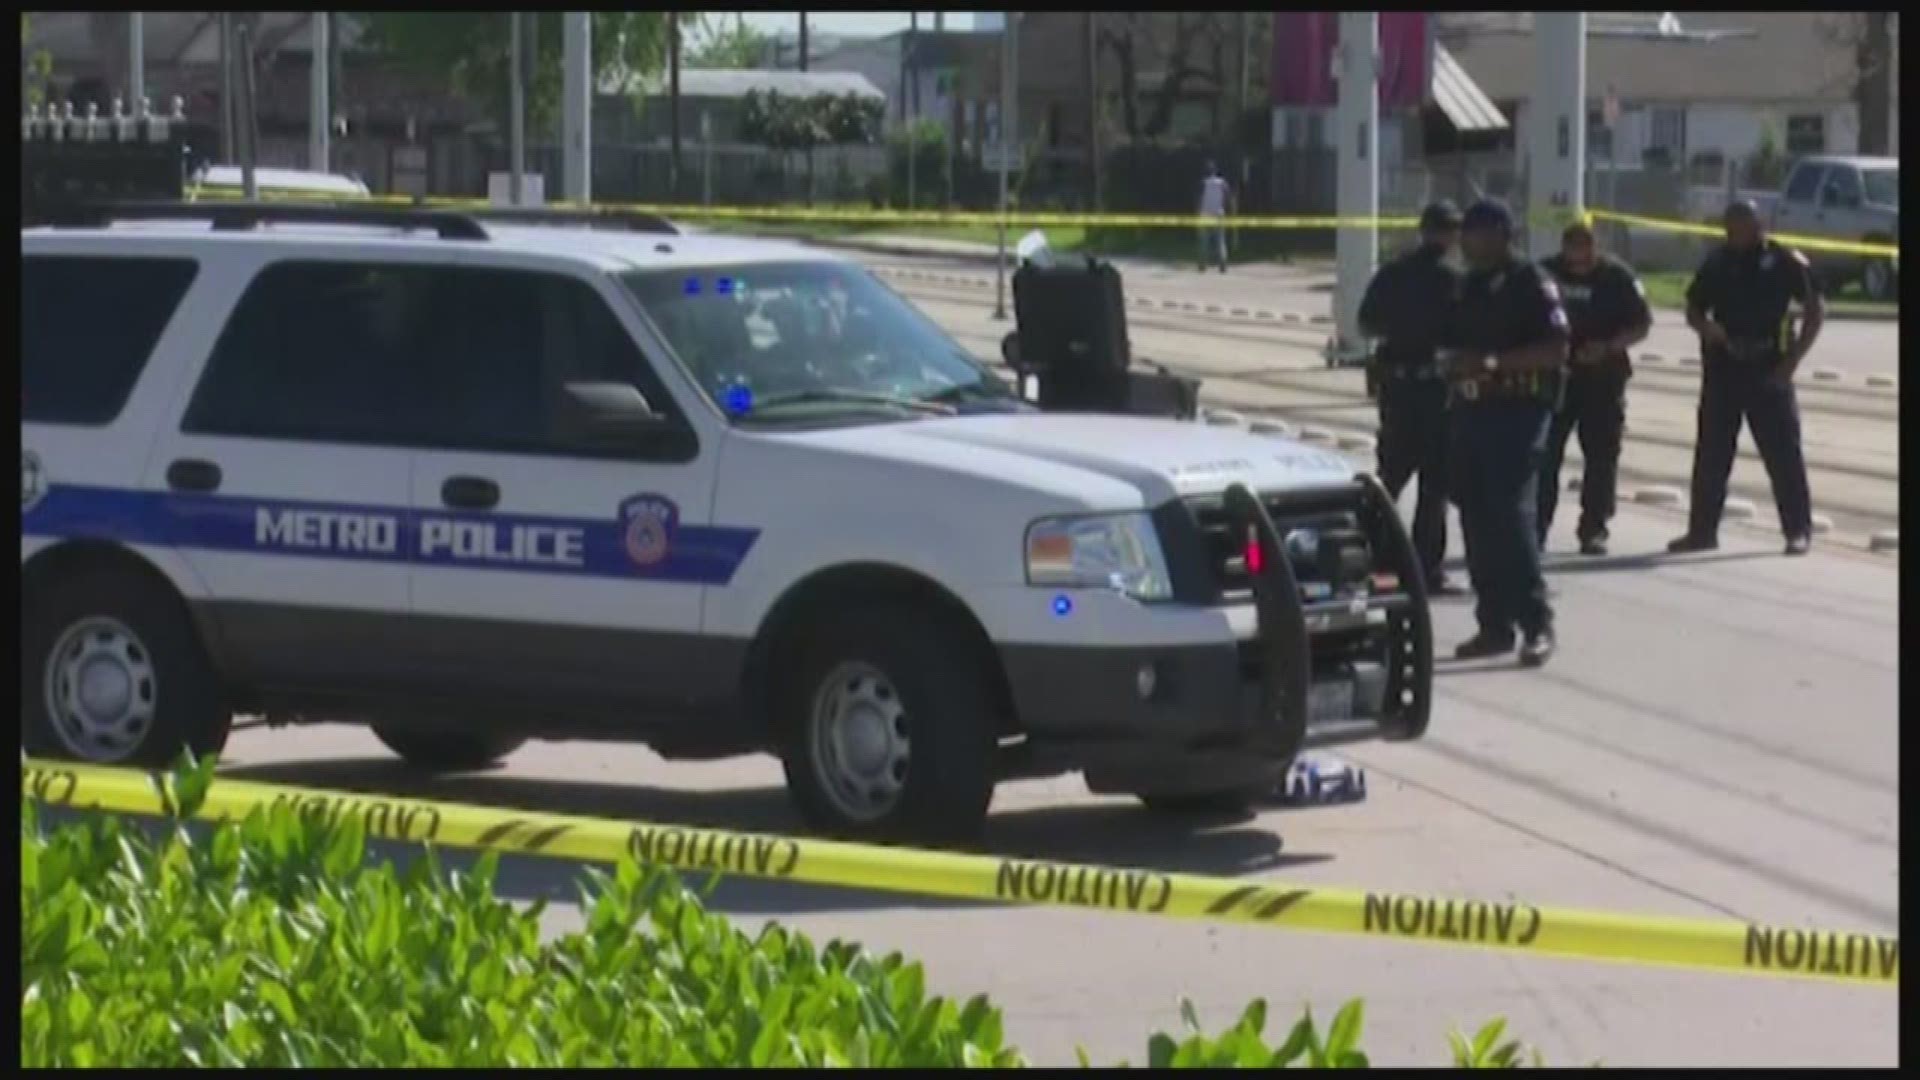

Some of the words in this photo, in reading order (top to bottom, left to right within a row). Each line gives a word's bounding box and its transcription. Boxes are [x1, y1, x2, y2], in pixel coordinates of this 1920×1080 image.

[255, 507, 397, 552] METRO
[419, 518, 585, 565] POLICE
[627, 826, 799, 877] CAUTION
[996, 859, 1172, 913] CAUTION
[1363, 892, 1542, 946] CAUTION
